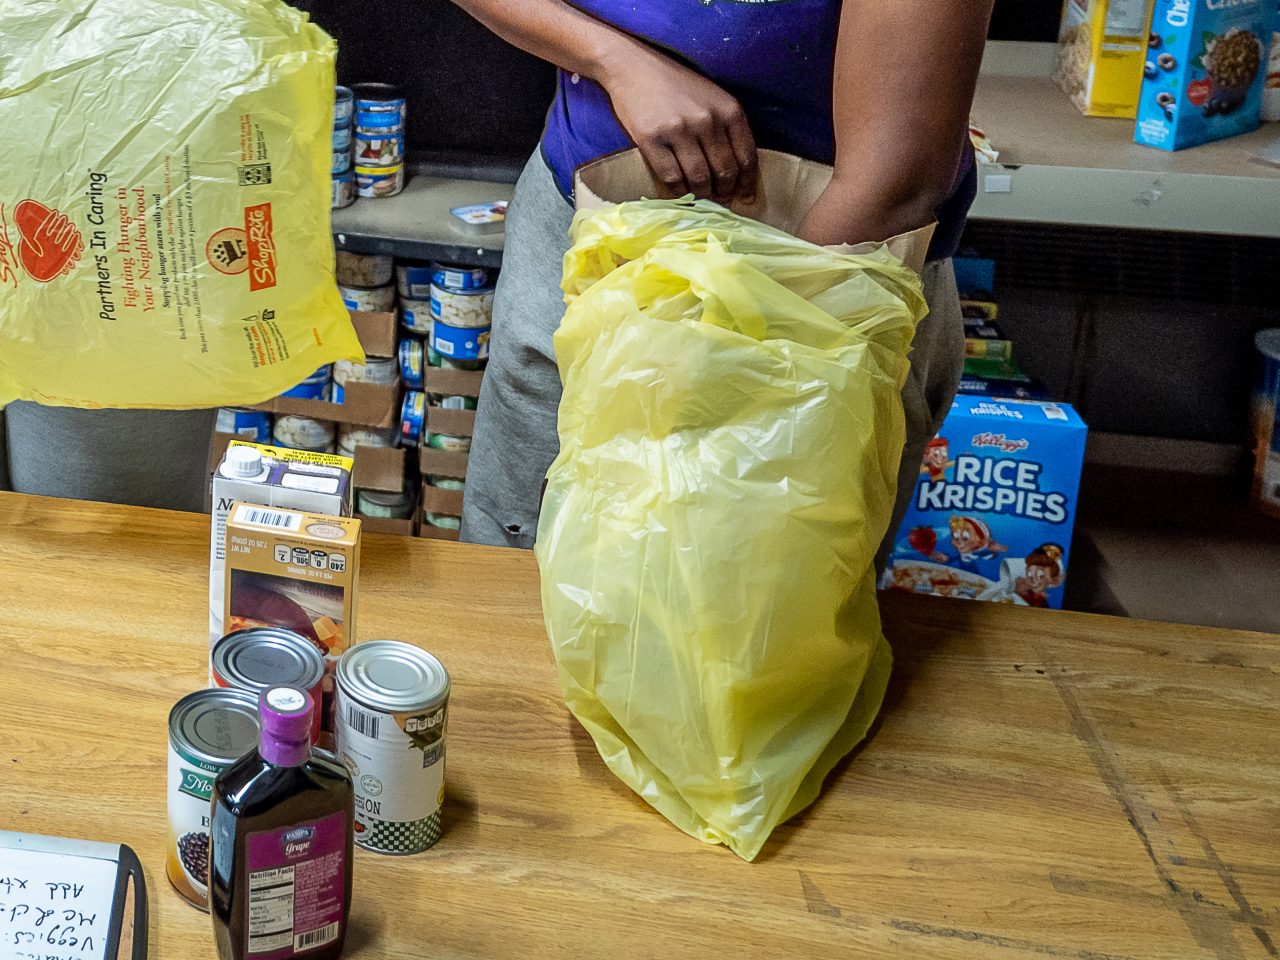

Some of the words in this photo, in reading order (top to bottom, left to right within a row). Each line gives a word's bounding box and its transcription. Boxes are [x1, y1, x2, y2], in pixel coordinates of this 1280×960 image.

[86, 171, 107, 226] Caring
[114, 187, 127, 200] in
[117, 204, 133, 254] Hunger
[154, 211, 162, 229] with
[89, 231, 106, 250] In
[132, 185, 153, 280] Neighborhood.
[156, 230, 165, 250] starts
[248, 209, 278, 284] ShopRite
[158, 251, 169, 276] hunger
[94, 255, 117, 321] Partners
[121, 257, 137, 309] Fighting
[142, 284, 156, 312] Your
[957, 455, 1041, 491] RICE
[919, 482, 1067, 523] KRISPIES
[231, 544, 239, 553] WT
[240, 546, 251, 554] NET
[330, 562, 344, 571] 240
[200, 761, 217, 772] LOW
[285, 841, 311, 856] Grape
[251, 871, 277, 879] Nutrition
[278, 868, 294, 876] Facts
[45, 882, 84, 899] Add
